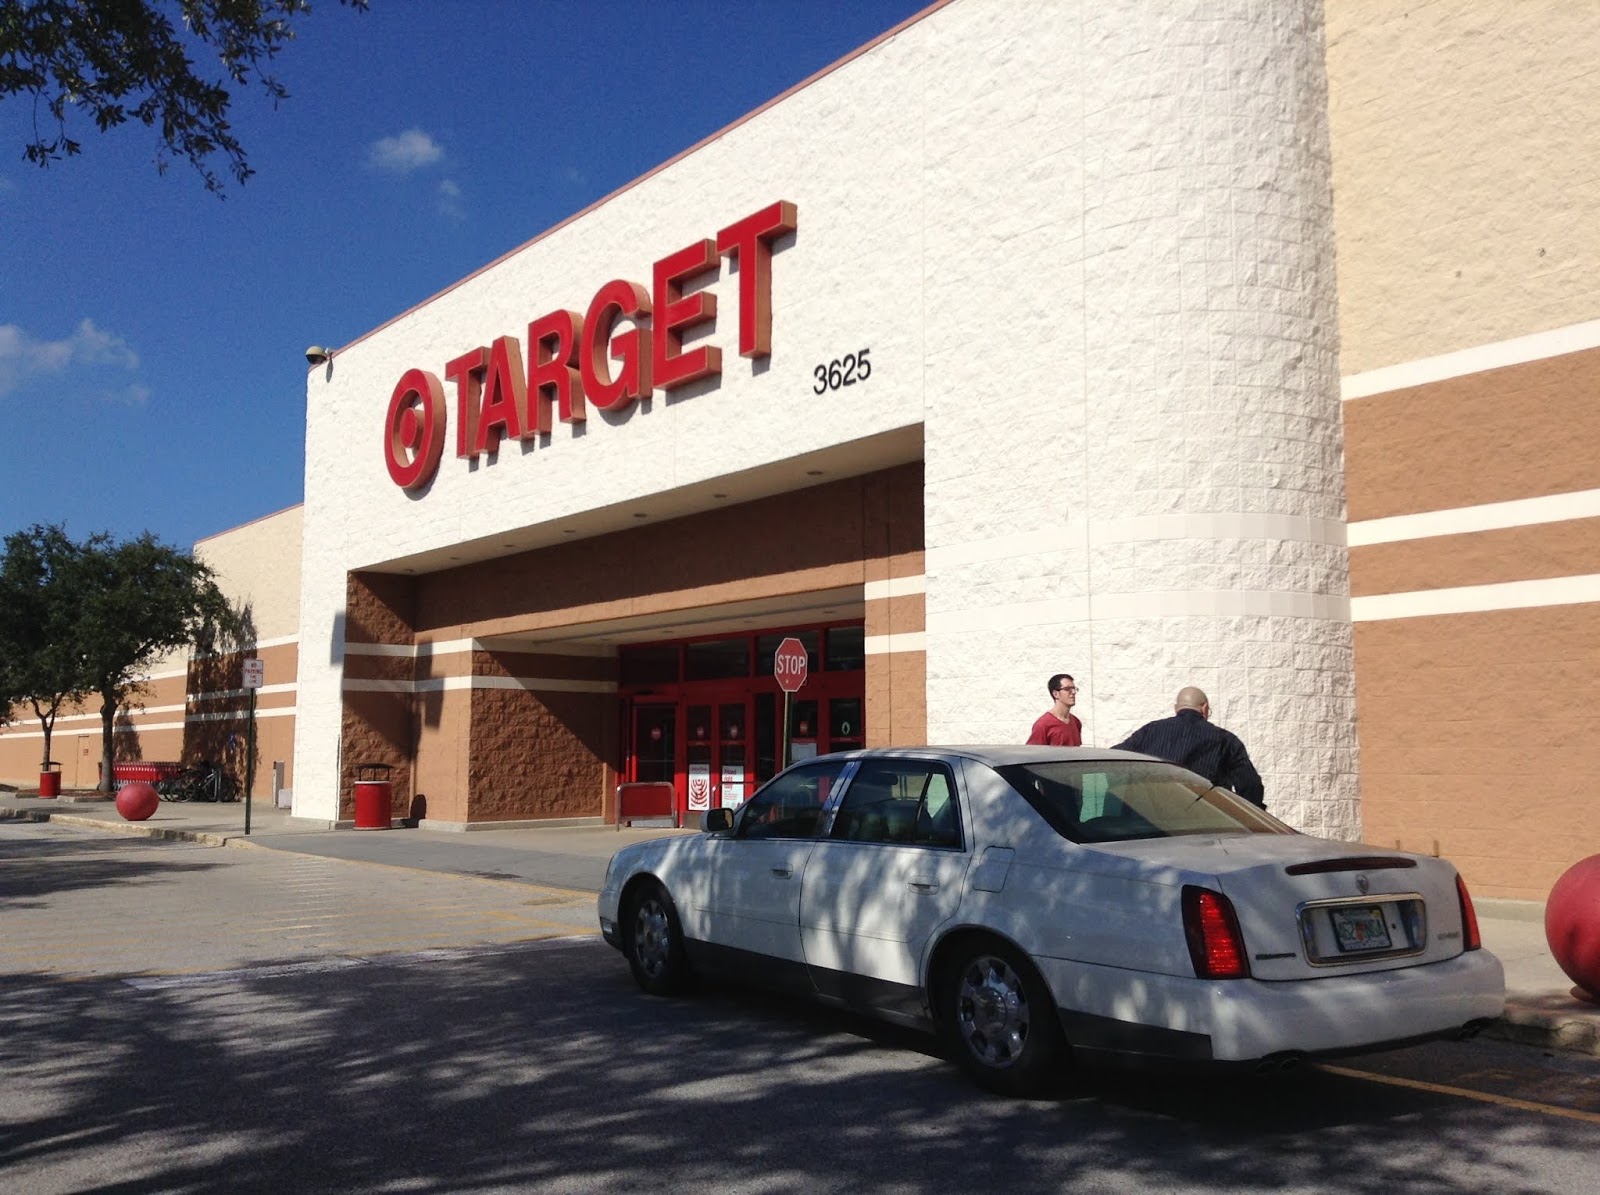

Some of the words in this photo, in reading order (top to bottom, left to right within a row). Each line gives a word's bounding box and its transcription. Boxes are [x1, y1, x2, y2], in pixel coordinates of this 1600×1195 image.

[445, 200, 796, 460] TARGET
[813, 348, 871, 395] 3625
[777, 654, 806, 675] STOP
